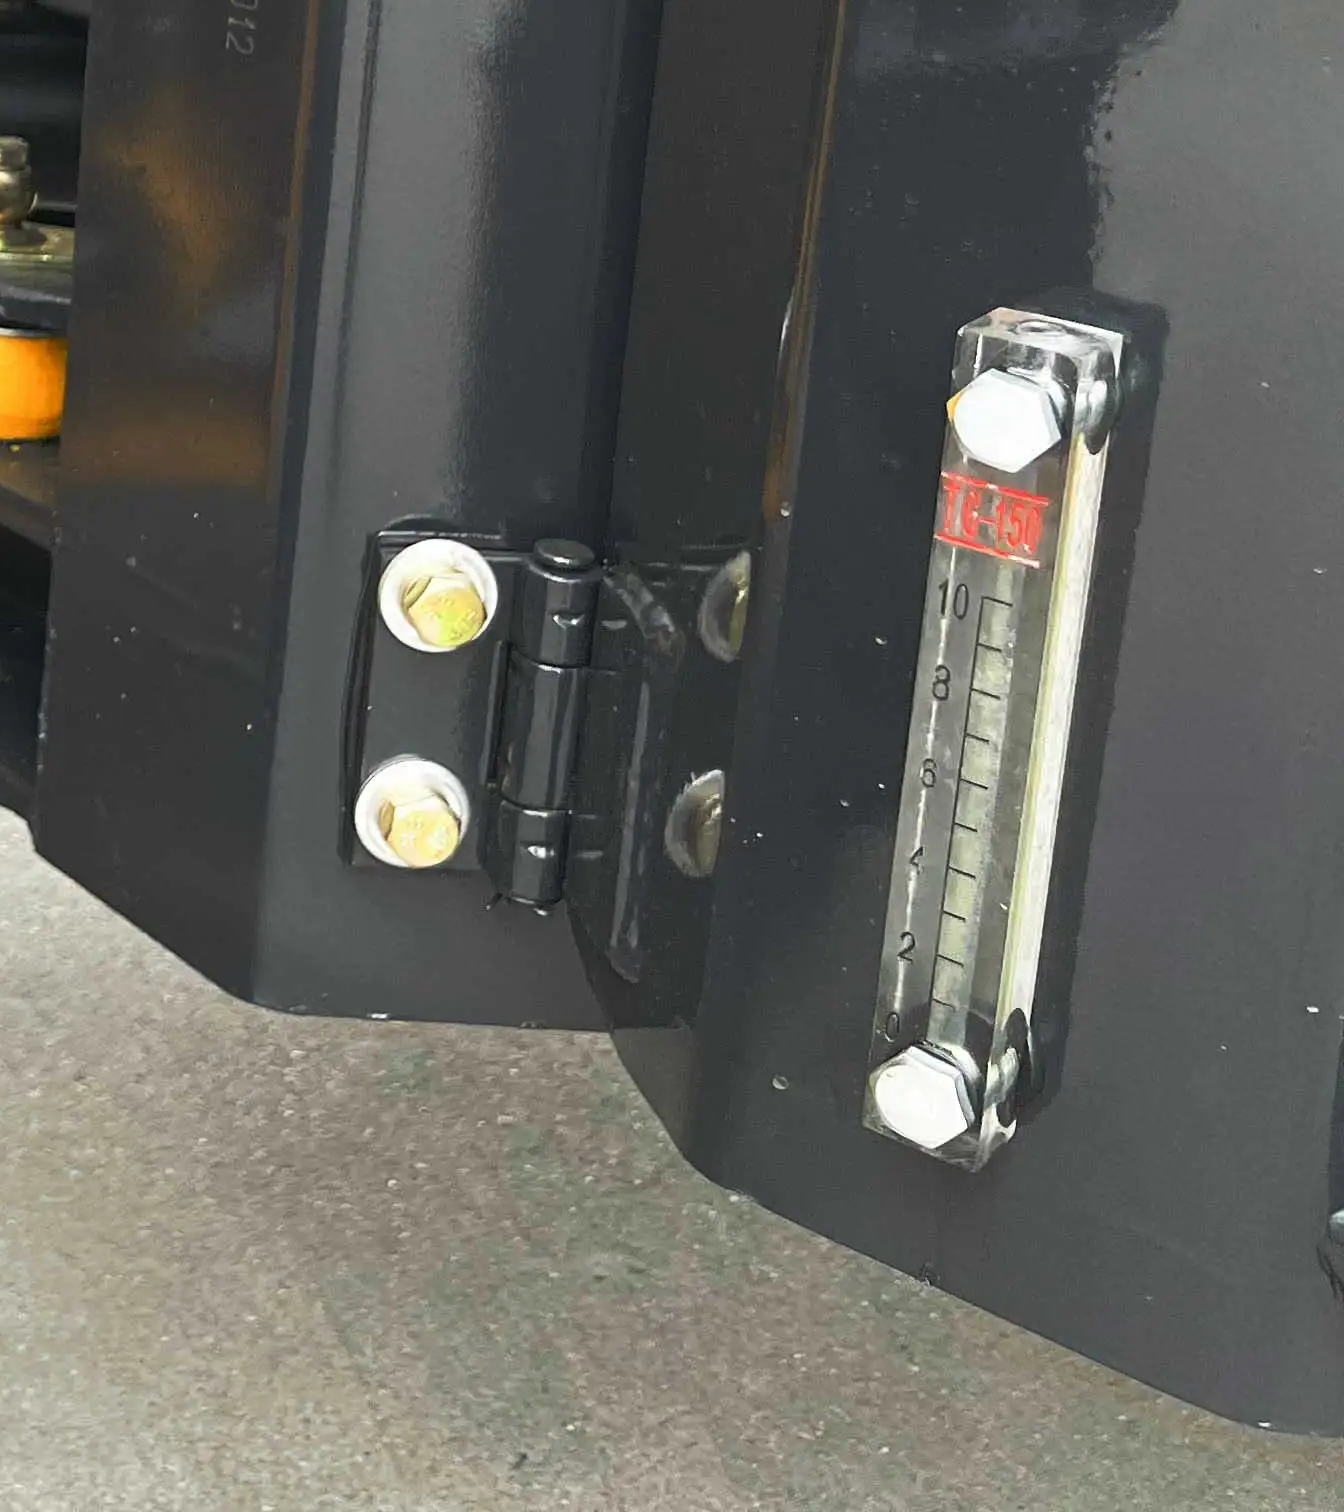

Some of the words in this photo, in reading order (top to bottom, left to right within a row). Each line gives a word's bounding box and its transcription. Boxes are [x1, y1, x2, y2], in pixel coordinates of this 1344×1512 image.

[938, 579, 970, 620] 10
[932, 664, 951, 701] 8
[897, 931, 916, 965] 2
